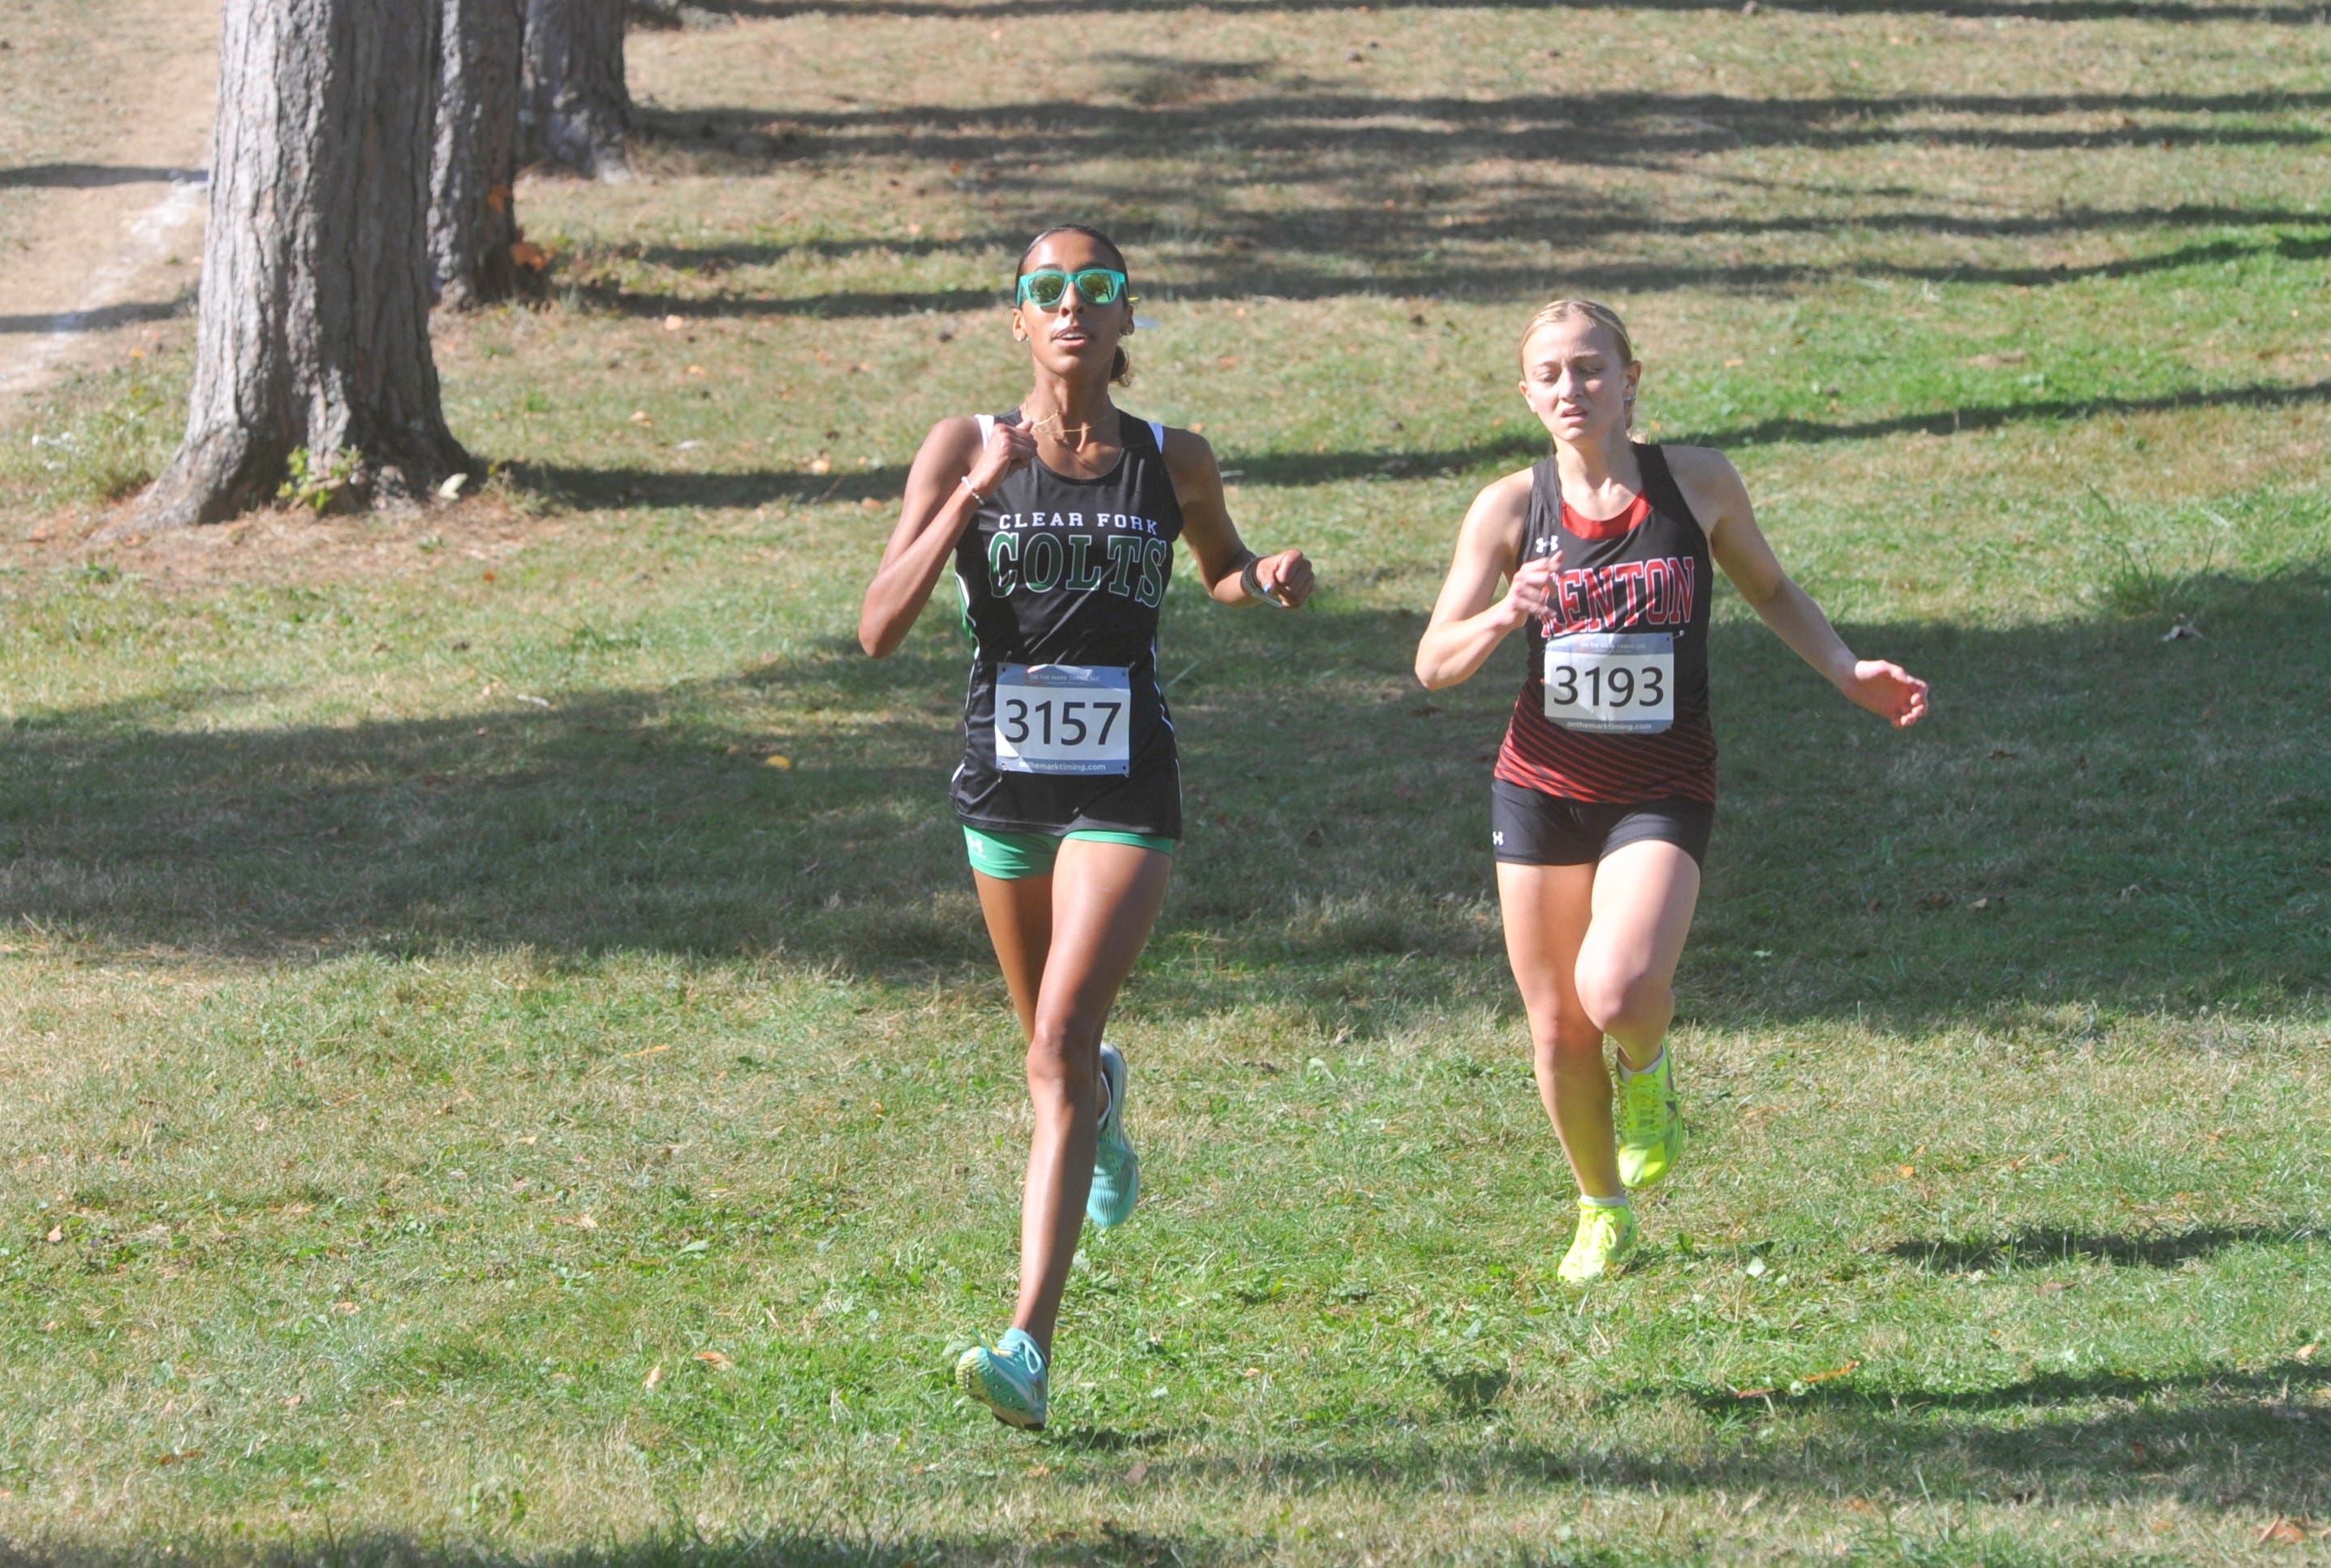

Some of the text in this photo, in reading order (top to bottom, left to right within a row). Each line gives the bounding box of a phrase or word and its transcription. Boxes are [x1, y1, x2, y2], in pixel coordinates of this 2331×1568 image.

[999, 512, 1157, 536] CLEAR FORK
[988, 531, 1167, 609] COLTS
[1553, 666, 1664, 709] 3193
[1005, 699, 1122, 746] 3157
